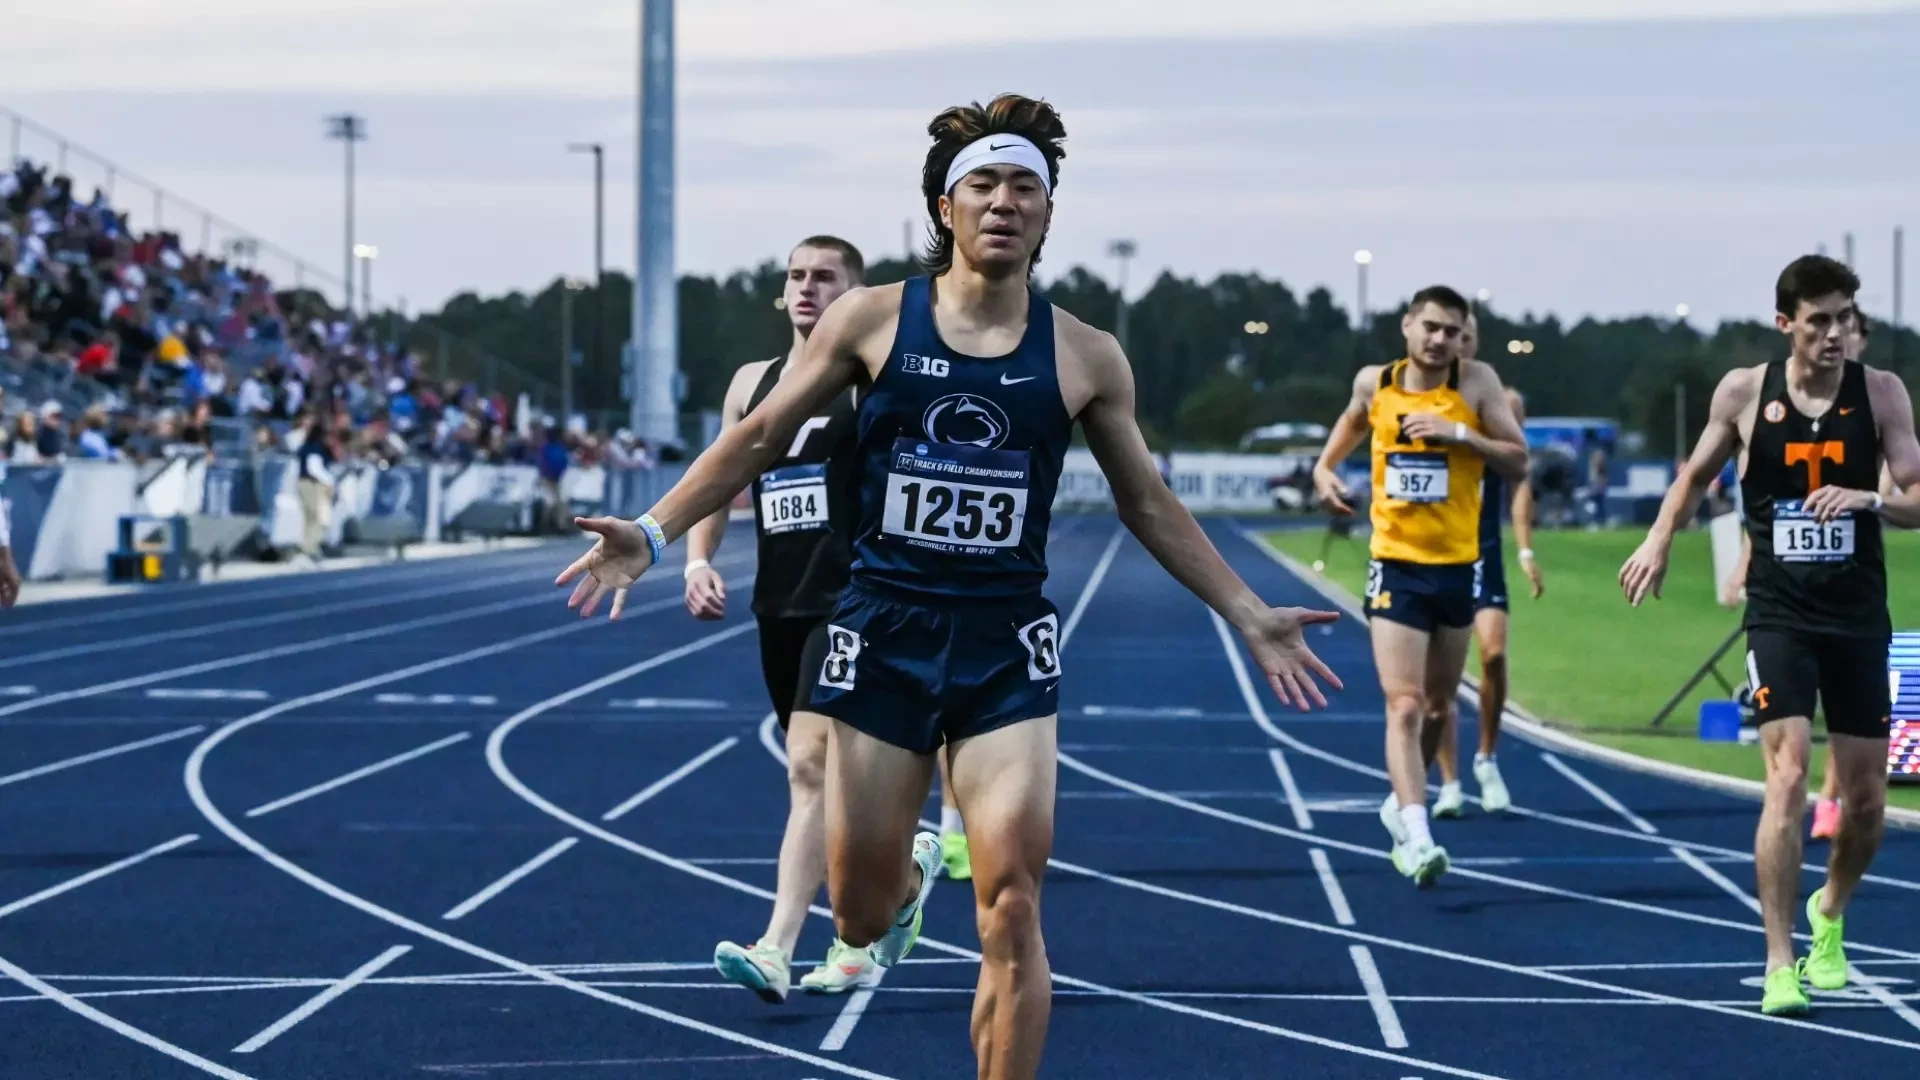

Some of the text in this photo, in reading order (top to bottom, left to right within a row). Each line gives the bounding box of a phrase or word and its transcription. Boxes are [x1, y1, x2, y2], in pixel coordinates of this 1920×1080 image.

[913, 459, 936, 471] TRACK
[937, 463, 943, 471] &
[943, 463, 964, 474] FIELD
[964, 467, 1024, 480] CHAMPIONSHIPS
[1784, 440, 1845, 497] T
[1400, 473, 1433, 493] 957
[771, 493, 817, 522] 1684
[901, 482, 1016, 542] 1253
[947, 545, 956, 553] FL
[1787, 526, 1844, 551] 1516
[825, 630, 854, 684] 6
[1027, 621, 1057, 675] 6
[1755, 686, 1771, 710] T
